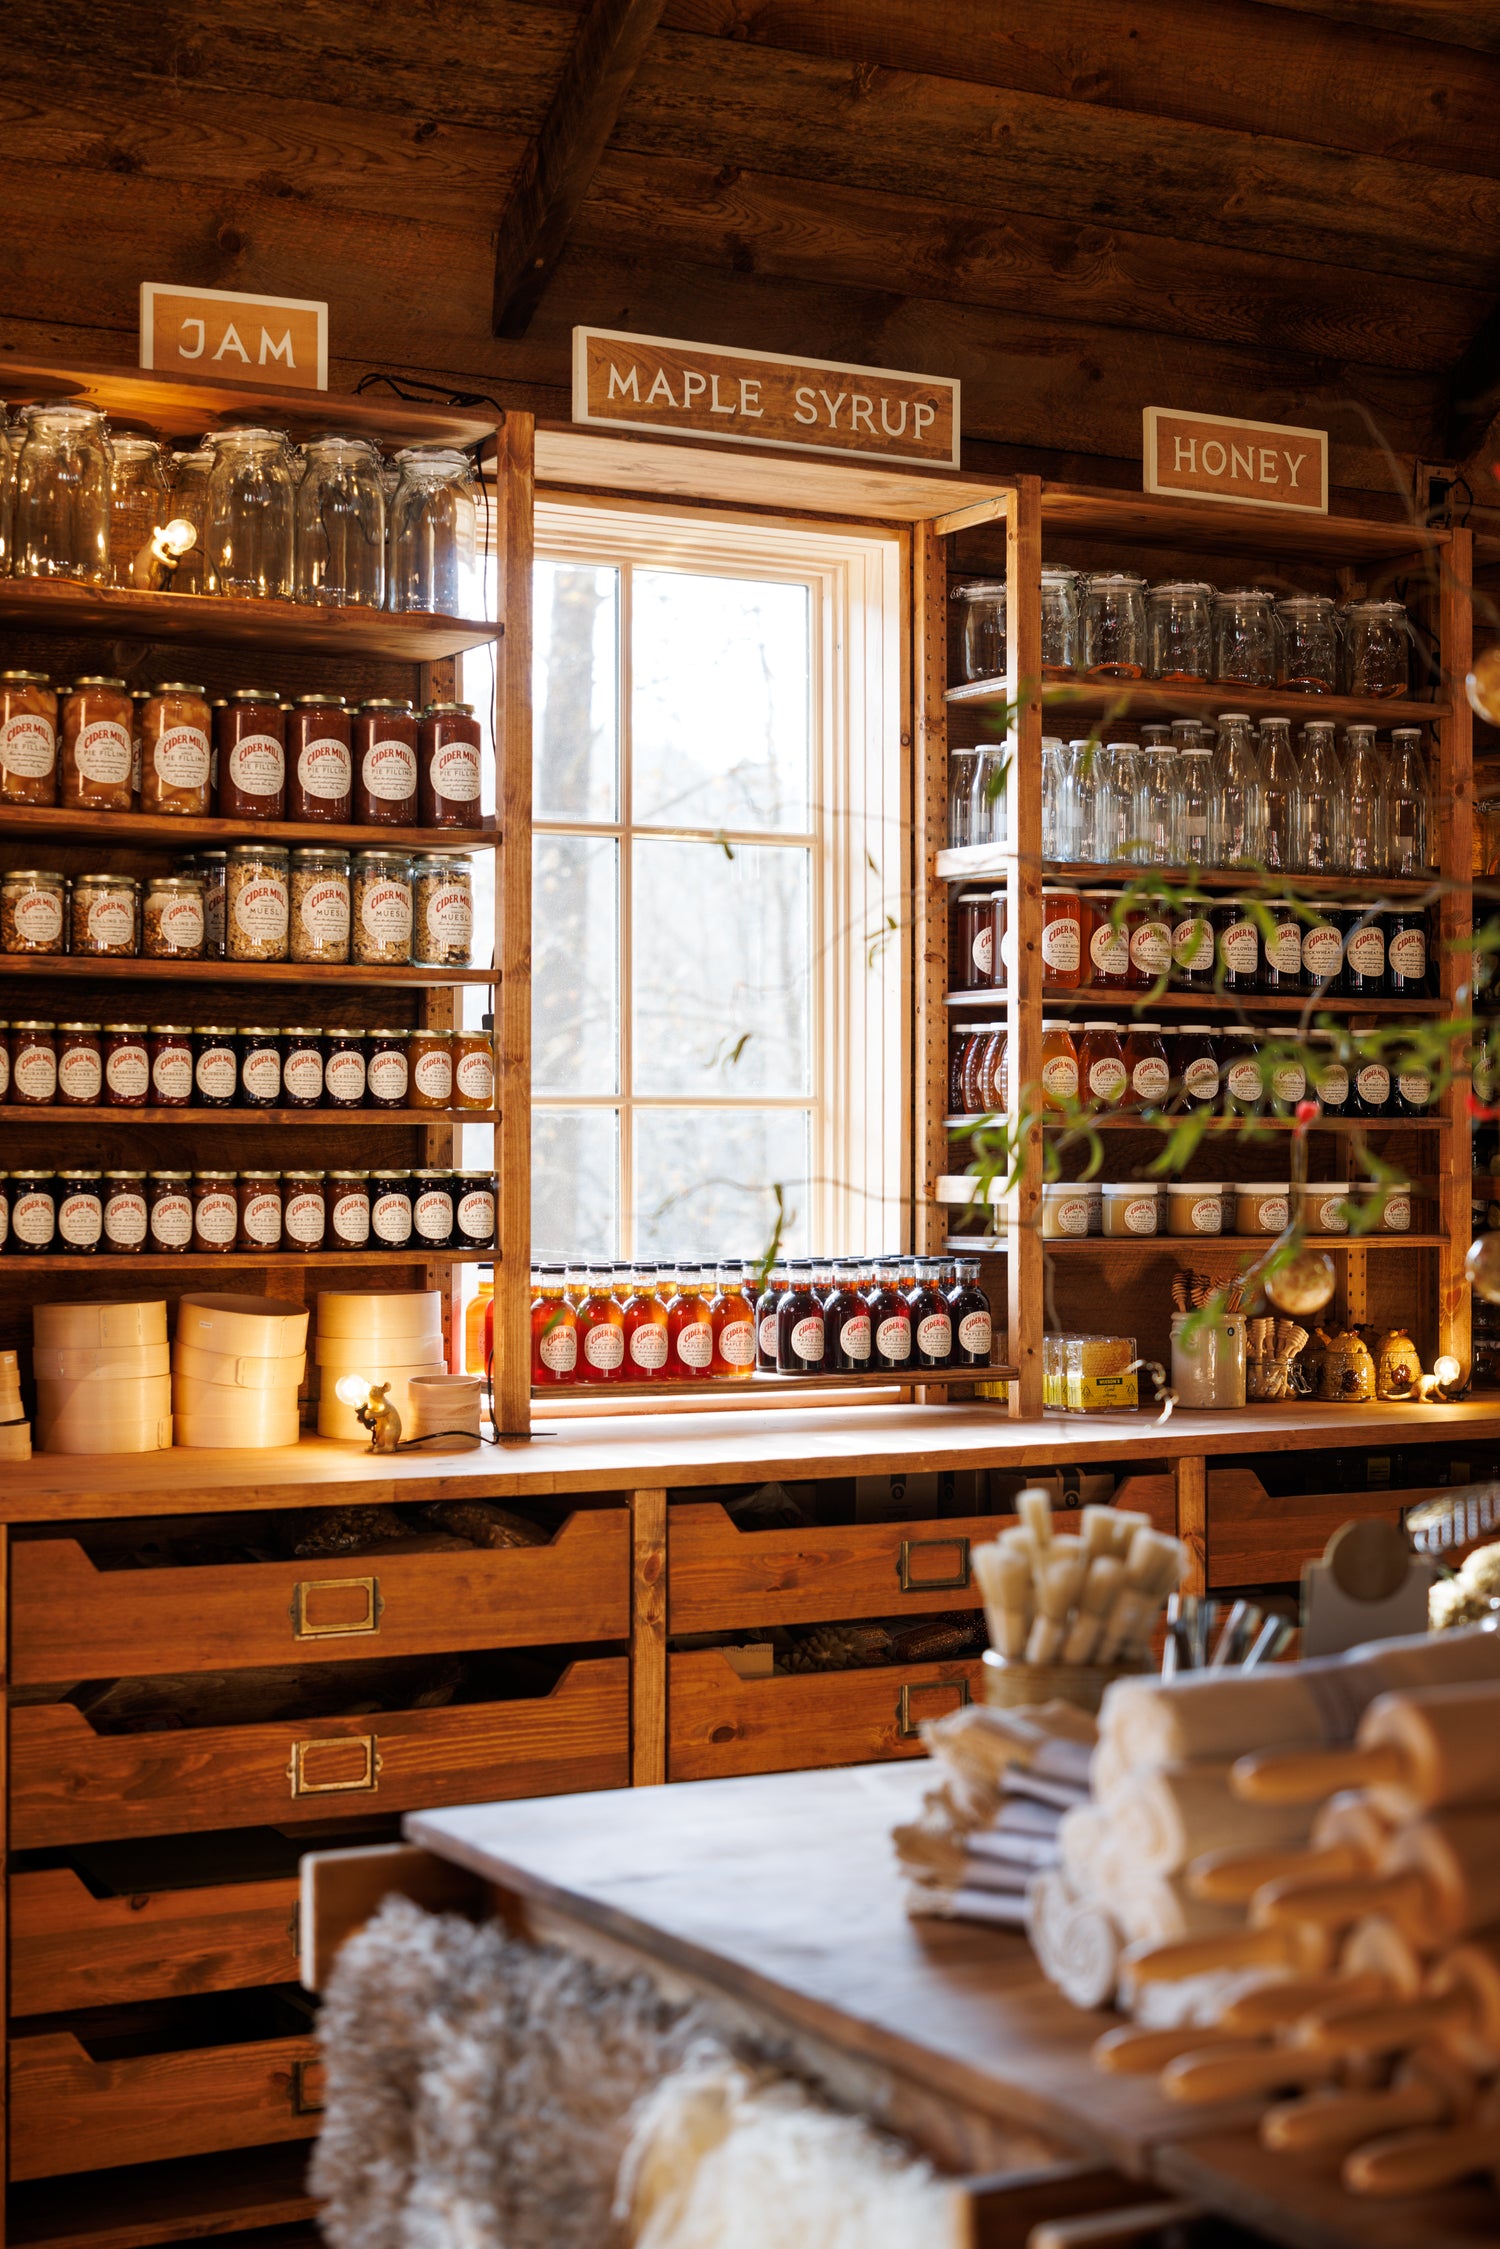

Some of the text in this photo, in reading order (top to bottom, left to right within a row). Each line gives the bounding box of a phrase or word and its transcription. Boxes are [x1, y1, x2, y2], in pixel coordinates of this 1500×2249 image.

[179, 318, 296, 368] JAM
[607, 362, 935, 440] MAPLE SYRUP
[1173, 436, 1307, 487] HONEY
[8, 723, 50, 744] CIDER MILL
[85, 730, 127, 750] CIDER MILL
[164, 735, 205, 755] CIDER MILL
[240, 743, 280, 764] CIDER MILL
[307, 747, 347, 767] CIDER MILL
[371, 749, 411, 768] CIDER MILL
[440, 750, 478, 769] CIDER MILL
[245, 887, 285, 908] CIDER MILL
[312, 889, 348, 909] CIDER MILL
[371, 891, 409, 910] CIDER MILL
[436, 894, 472, 913] CIDER MILL
[22, 898, 57, 914] CIDER MILL
[96, 902, 129, 918] CIDER MILL
[169, 905, 200, 921] CIDER MILL
[1049, 925, 1068, 942] CIDER
[1138, 930, 1160, 945] CIDER
[1228, 929, 1247, 945] CIDER
[1309, 933, 1340, 949] CIDER MILL
[1356, 934, 1383, 949] CIDER MILL
[1397, 936, 1415, 951] CIDER
[22, 1054, 40, 1069] CIDER
[65, 1055, 84, 1070] CIDER
[114, 1053, 132, 1068] CIDER
[161, 1055, 179, 1070] CIDER
[204, 1055, 222, 1070] CIDER
[250, 1056, 268, 1070] CIDER
[291, 1056, 309, 1071] CIDER
[332, 1058, 350, 1072] CIDER
[374, 1058, 391, 1073] CIDER
[423, 1058, 440, 1071] CIDER
[463, 1059, 481, 1073] CIDER
[1049, 1061, 1075, 1075] CIDER MILL
[1097, 1063, 1122, 1076] CIDER MILL
[1140, 1063, 1165, 1076] CIDER MILL
[1192, 1065, 1217, 1077] CIDER MILL
[1235, 1067, 1251, 1078] CIDER
[1364, 1070, 1386, 1082] CIDER MILL
[20, 1200, 39, 1216] CIDER
[66, 1201, 84, 1217] CIDER
[110, 1201, 129, 1216] CIDER
[158, 1202, 176, 1217] CIDER
[202, 1201, 220, 1216] CIDER
[252, 1201, 270, 1216] CIDER
[292, 1201, 310, 1216] CIDER
[340, 1200, 358, 1215] CIDER
[379, 1200, 396, 1215] CIDER
[420, 1198, 437, 1213] CIDER
[465, 1198, 482, 1212] CIDER
[1065, 1205, 1078, 1214] CIDER
[1131, 1205, 1145, 1214] CIDER
[799, 1322, 815, 1336] CIDER
[848, 1321, 862, 1335] CIDER
[883, 1320, 899, 1336] CIDER
[924, 1318, 939, 1333] CIDER
[966, 1317, 981, 1331] CIDER
[548, 1332, 565, 1346] CIDER
[592, 1330, 608, 1344] CIDER
[637, 1329, 654, 1343] CIDER
[684, 1328, 700, 1342] CIDER
[726, 1327, 743, 1341] CIDER
